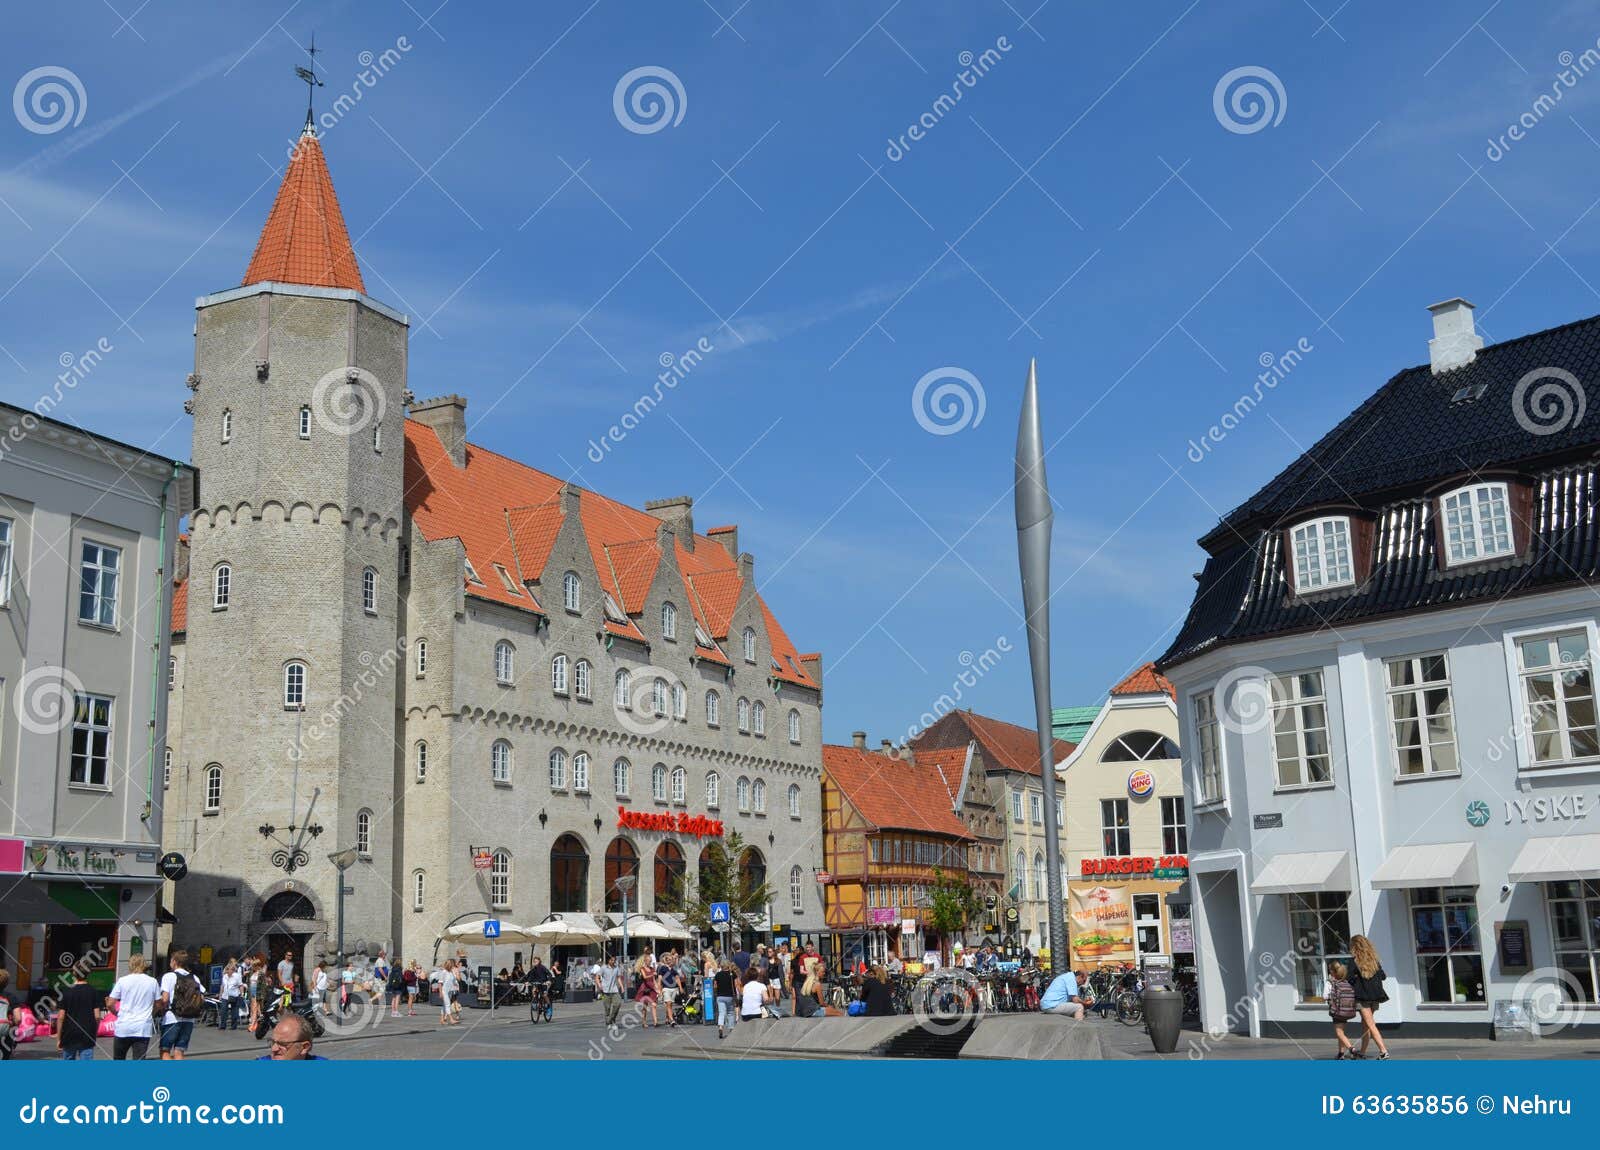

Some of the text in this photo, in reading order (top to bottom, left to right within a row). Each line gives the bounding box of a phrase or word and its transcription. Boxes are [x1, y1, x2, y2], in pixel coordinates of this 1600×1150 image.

[1131, 779, 1151, 789] KING
[1503, 794, 1586, 825] JYSKE
[54, 845, 117, 873] The Harp
[1081, 857, 1156, 875] BURGER
